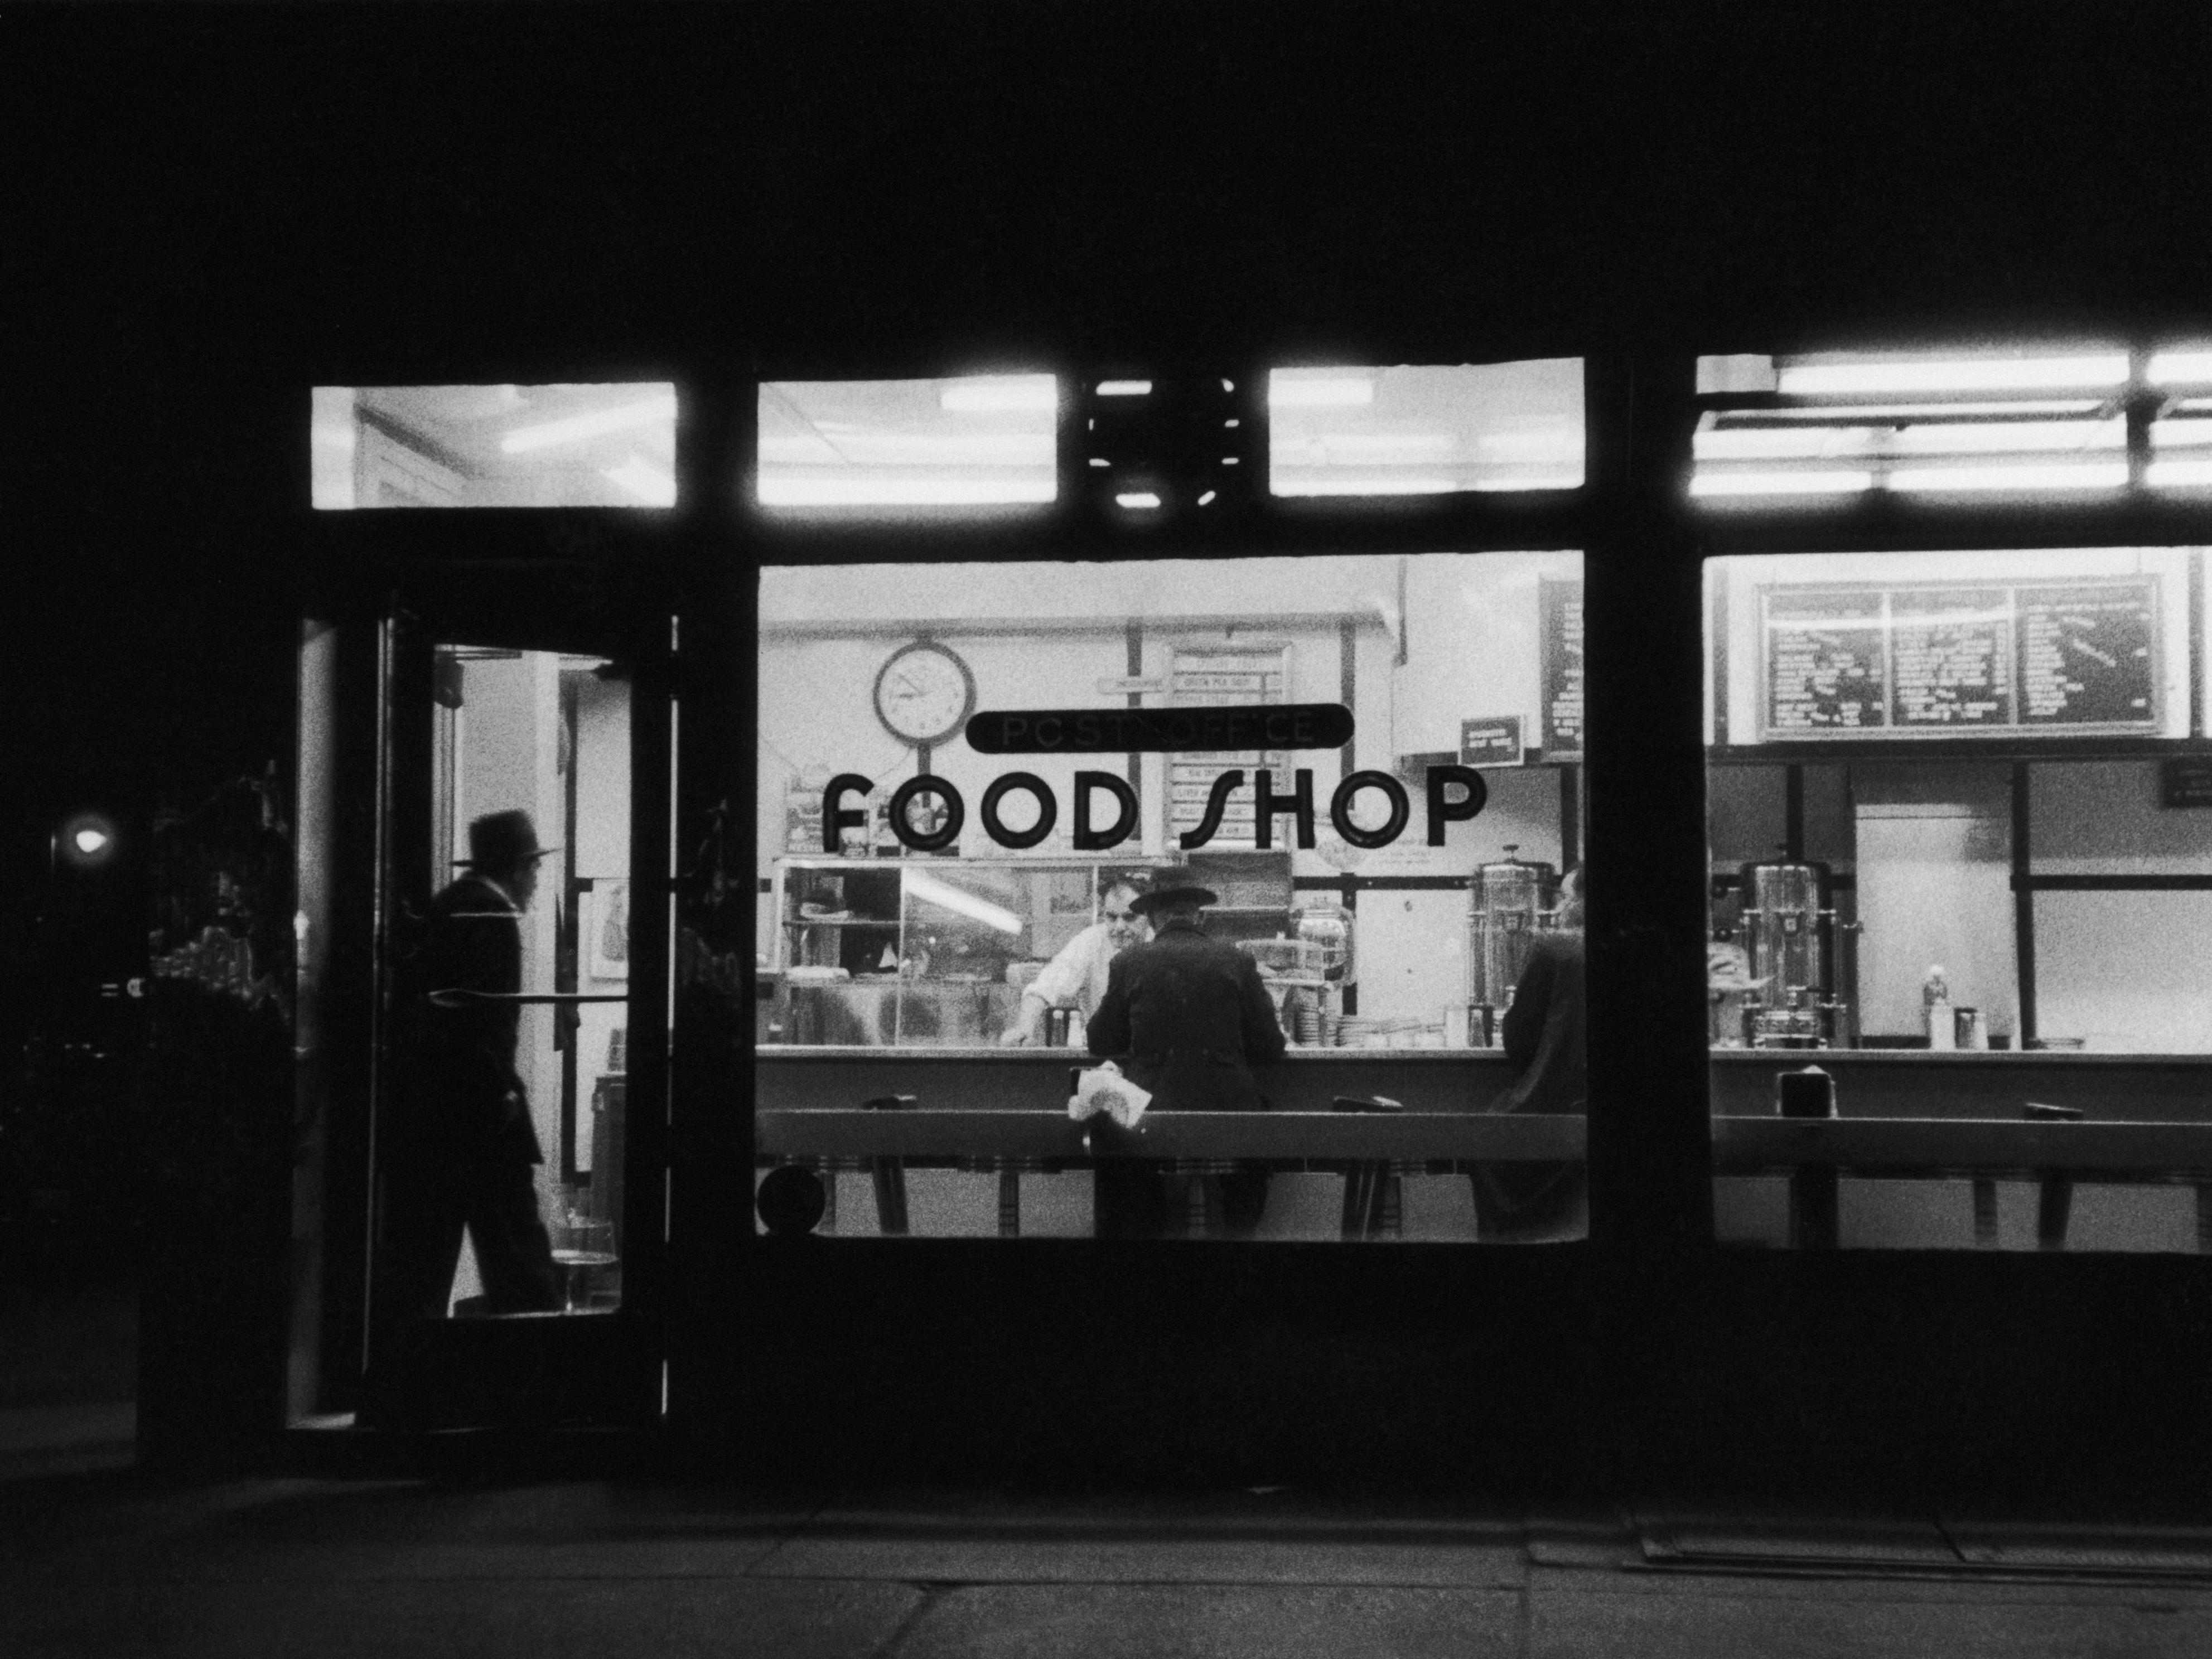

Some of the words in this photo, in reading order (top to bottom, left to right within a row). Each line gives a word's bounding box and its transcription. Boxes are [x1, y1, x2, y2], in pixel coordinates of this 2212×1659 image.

[1002, 714, 1129, 748] POST
[823, 771, 1138, 853] FOOD
[1180, 766, 1487, 850] SHOP
